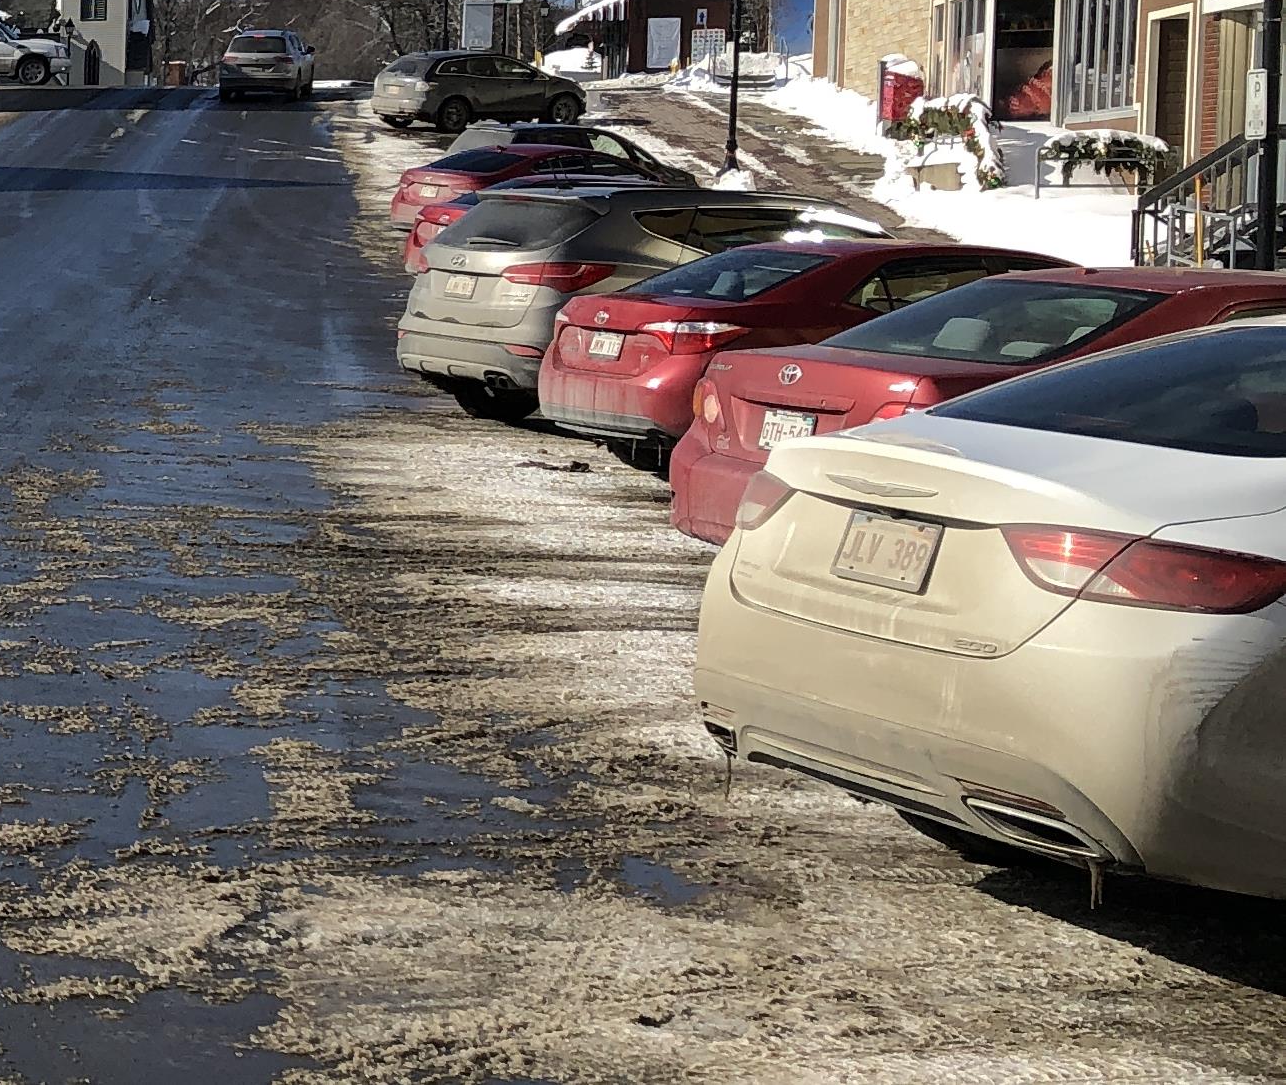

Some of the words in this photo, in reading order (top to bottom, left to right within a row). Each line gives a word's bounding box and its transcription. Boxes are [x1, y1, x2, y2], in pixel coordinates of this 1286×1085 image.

[1255, 81, 1260, 97] P
[843, 530, 884, 565] JLV
[888, 538, 929, 571] 389
